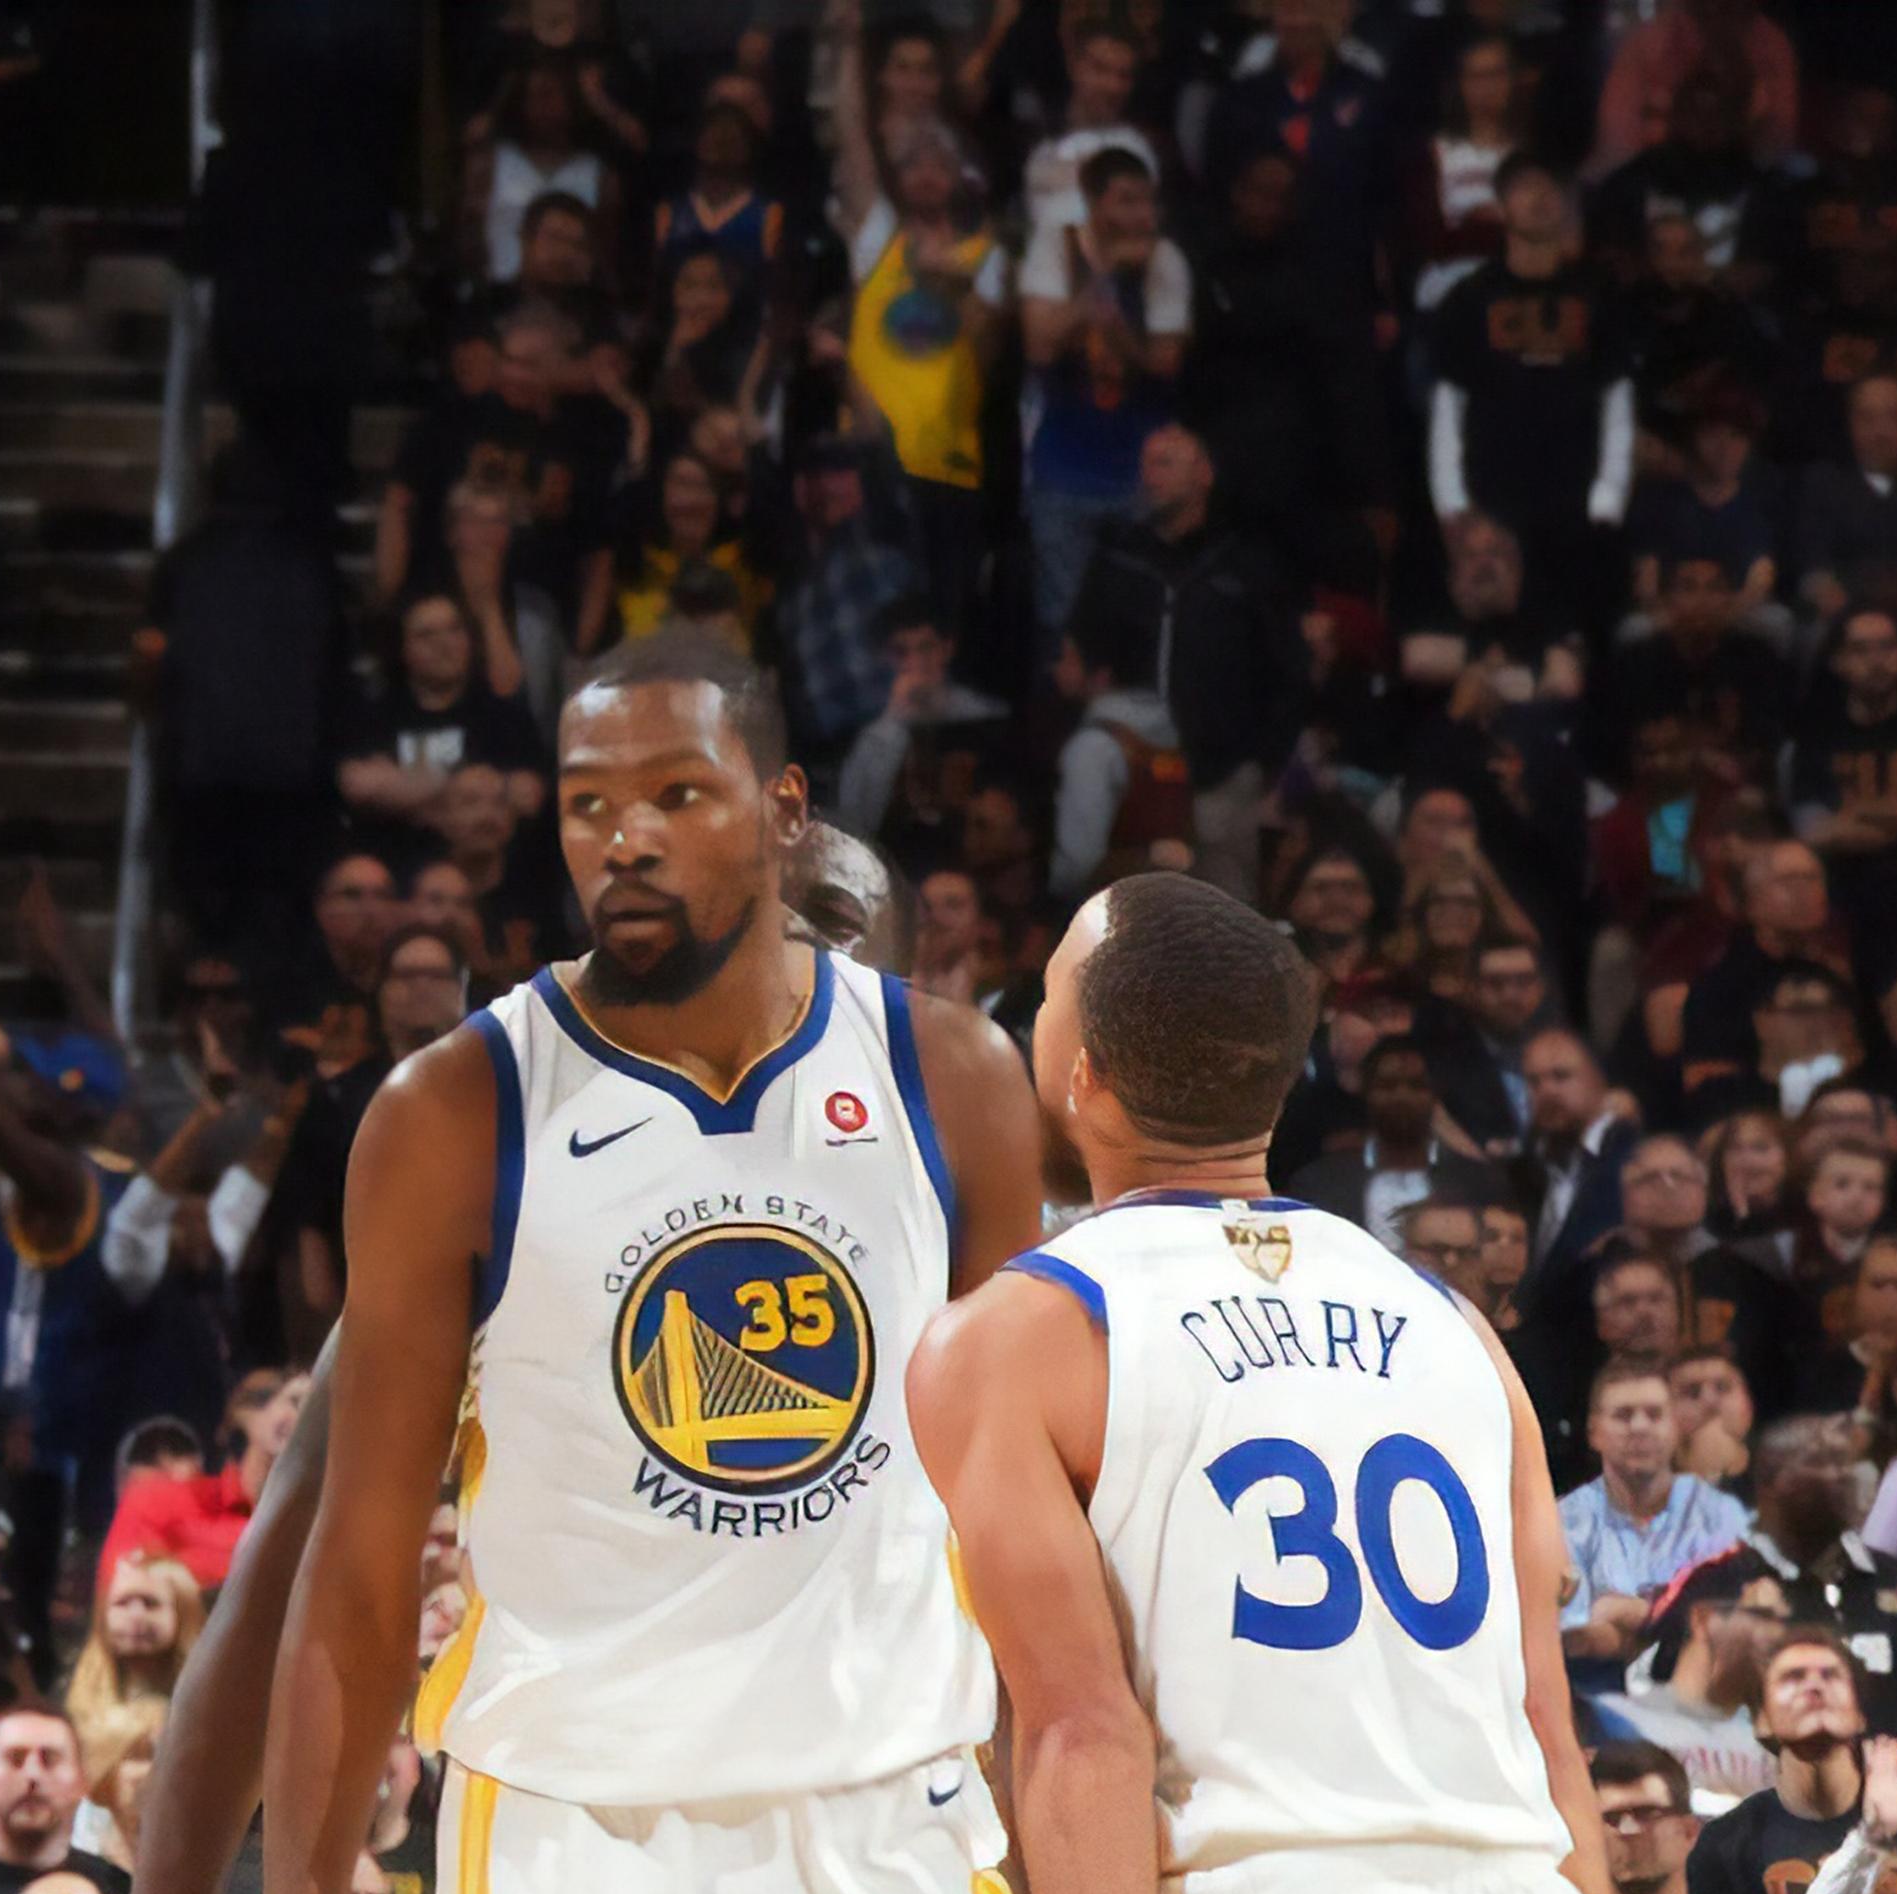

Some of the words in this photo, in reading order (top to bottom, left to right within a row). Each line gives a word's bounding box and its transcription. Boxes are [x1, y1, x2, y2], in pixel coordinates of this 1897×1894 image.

[604, 1194, 744, 1293] GOLDEN
[765, 1195, 871, 1265] STATE
[734, 1273, 836, 1353] 35
[1181, 1296, 1408, 1384] CURRY
[632, 1434, 891, 1537] WARRIORS
[1204, 1432, 1491, 1651] 30
